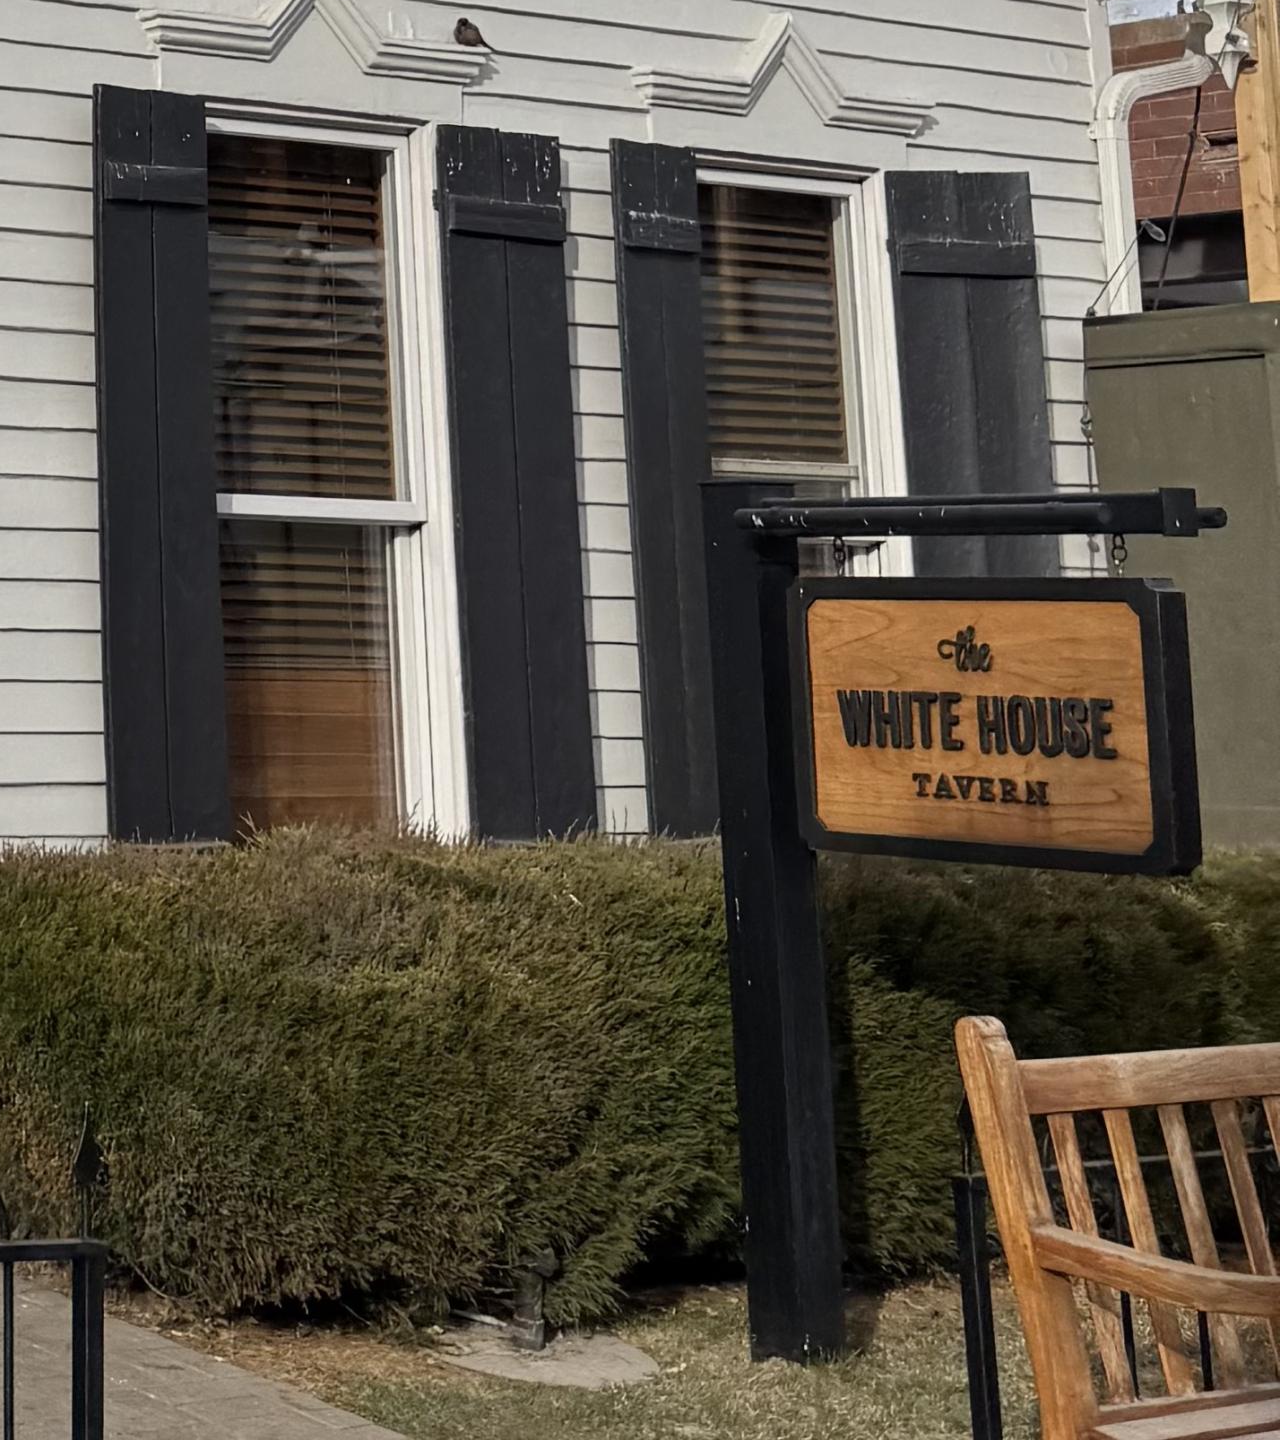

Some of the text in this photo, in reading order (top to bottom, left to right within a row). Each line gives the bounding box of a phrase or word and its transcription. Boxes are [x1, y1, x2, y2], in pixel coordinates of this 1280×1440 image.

[937, 625, 994, 673] the
[837, 689, 1119, 761] WHITE HOUSE
[912, 772, 1050, 807] TAVERN
